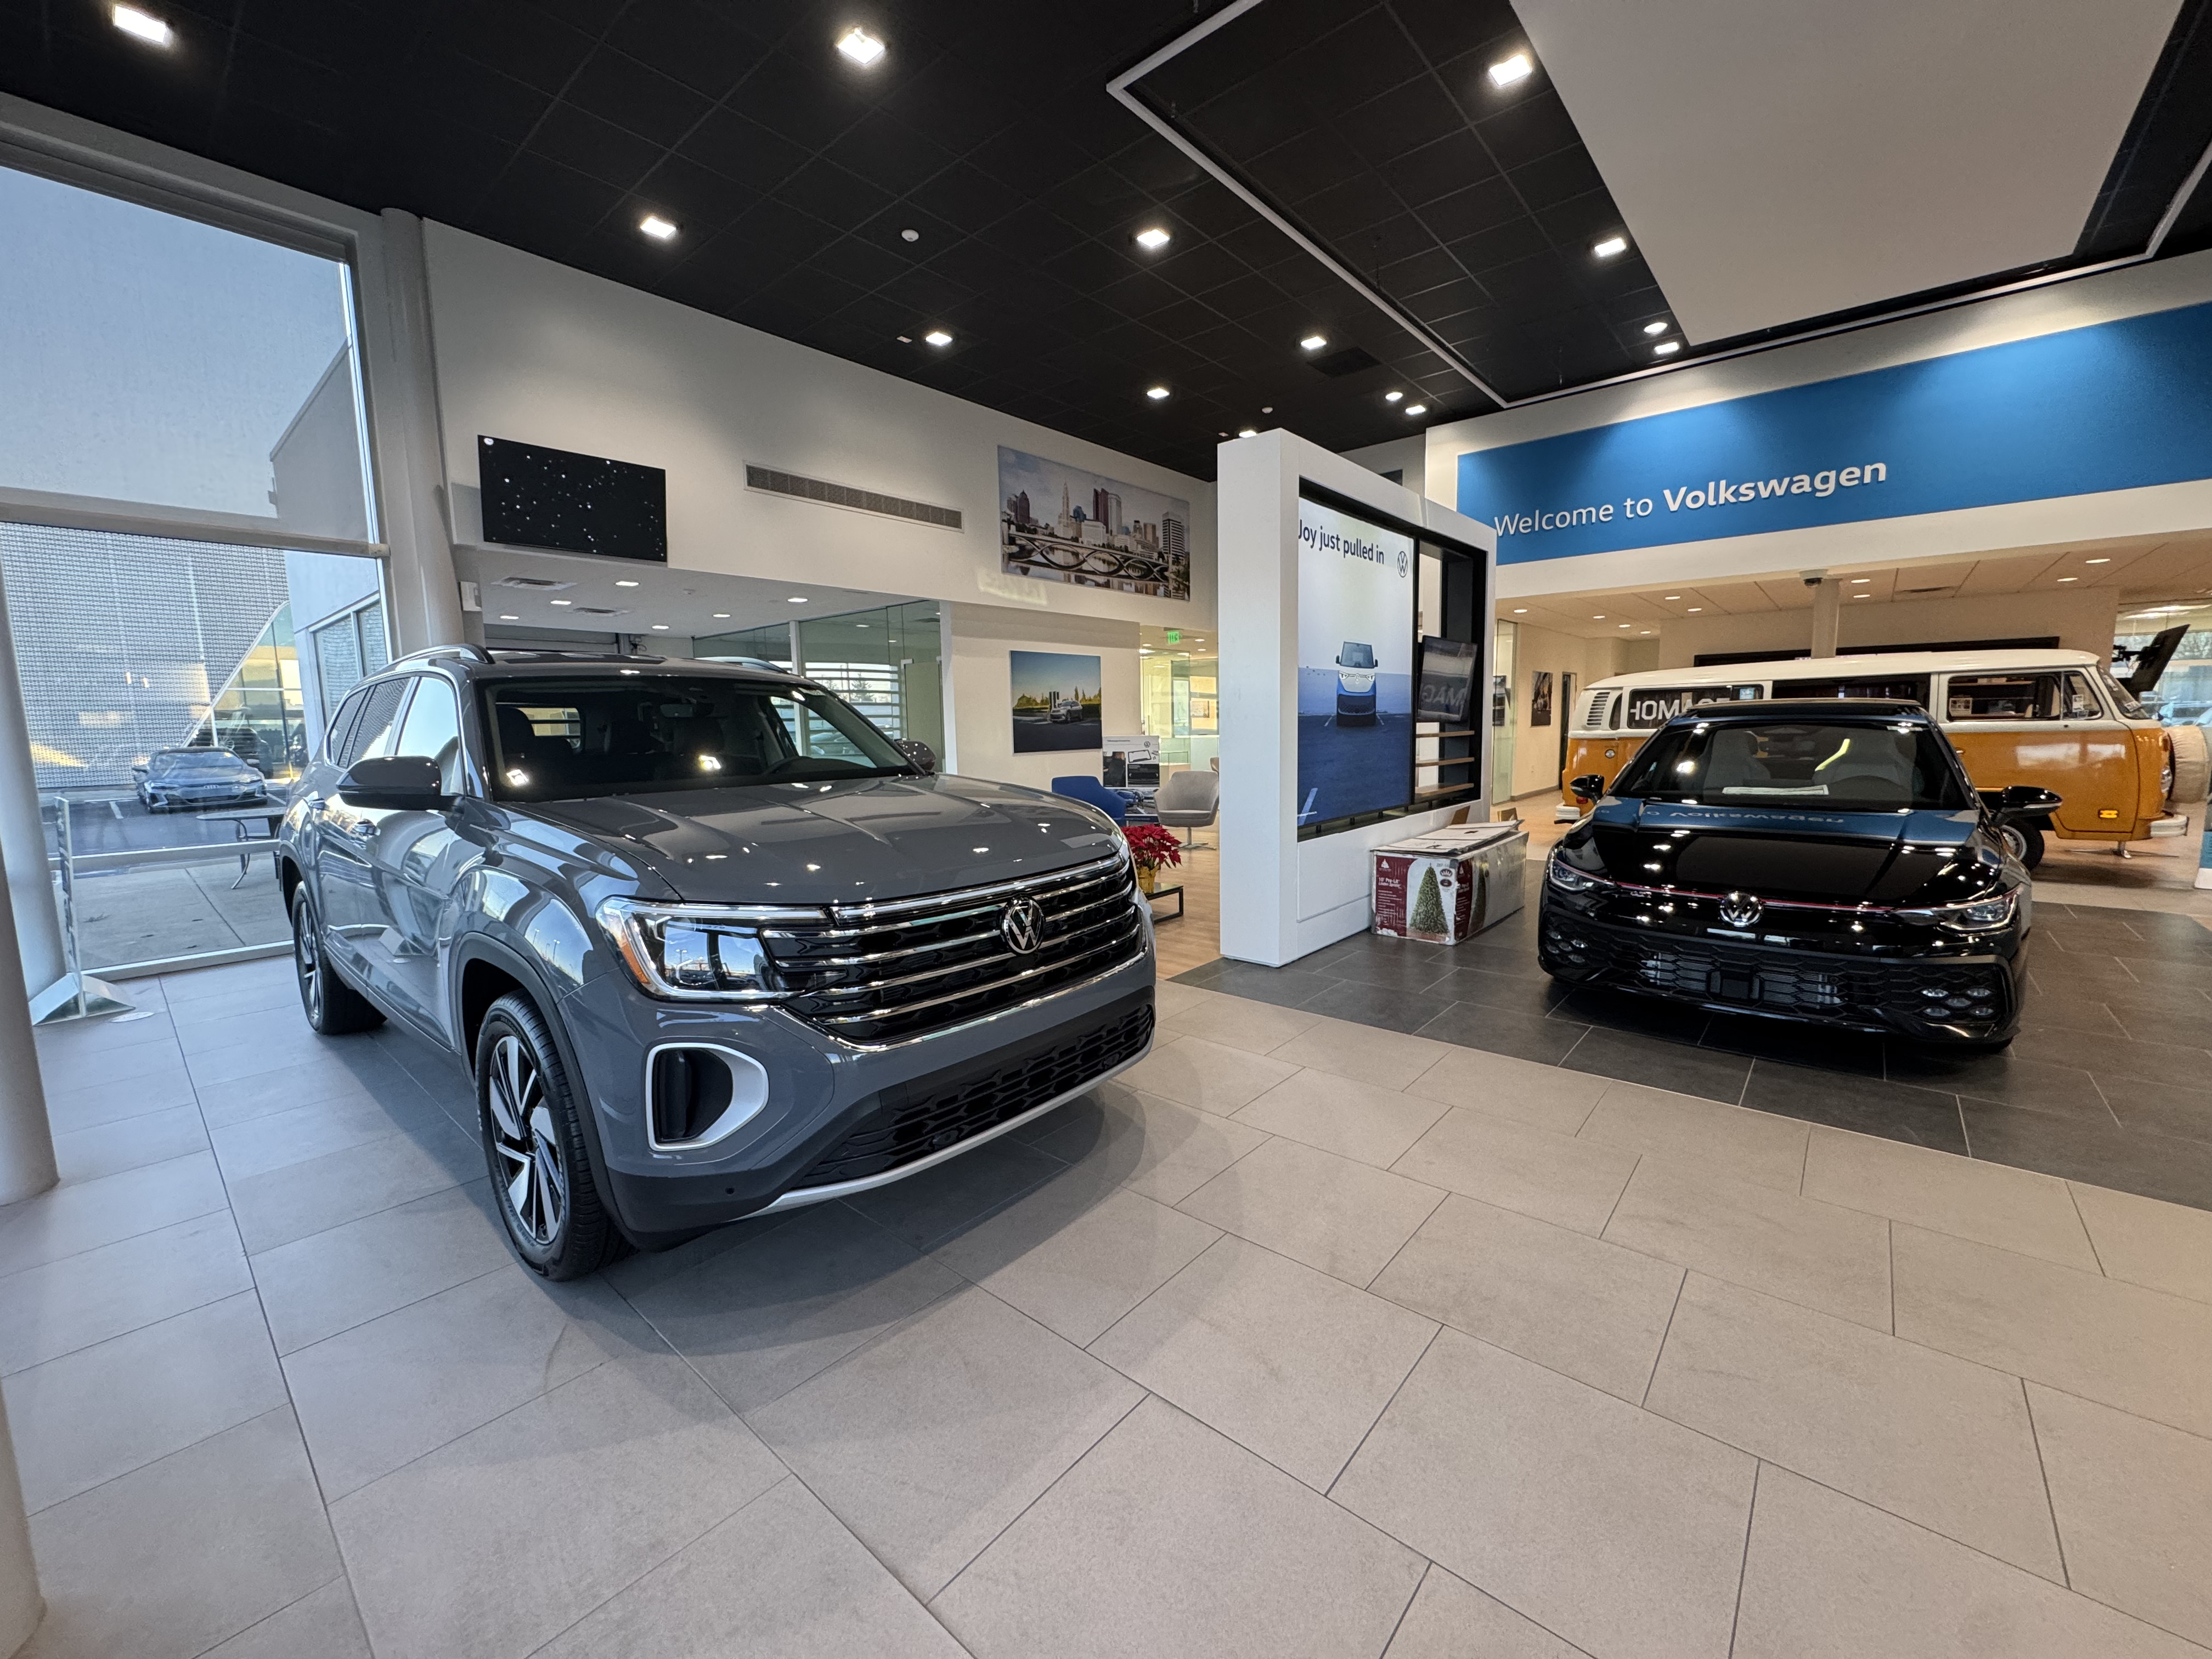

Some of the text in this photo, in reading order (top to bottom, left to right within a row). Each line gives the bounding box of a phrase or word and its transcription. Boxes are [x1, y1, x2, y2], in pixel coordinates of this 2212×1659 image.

[1494, 462, 1886, 537] Welcome to Volkswagen
[1298, 519, 1384, 565] Joy just pulled in
